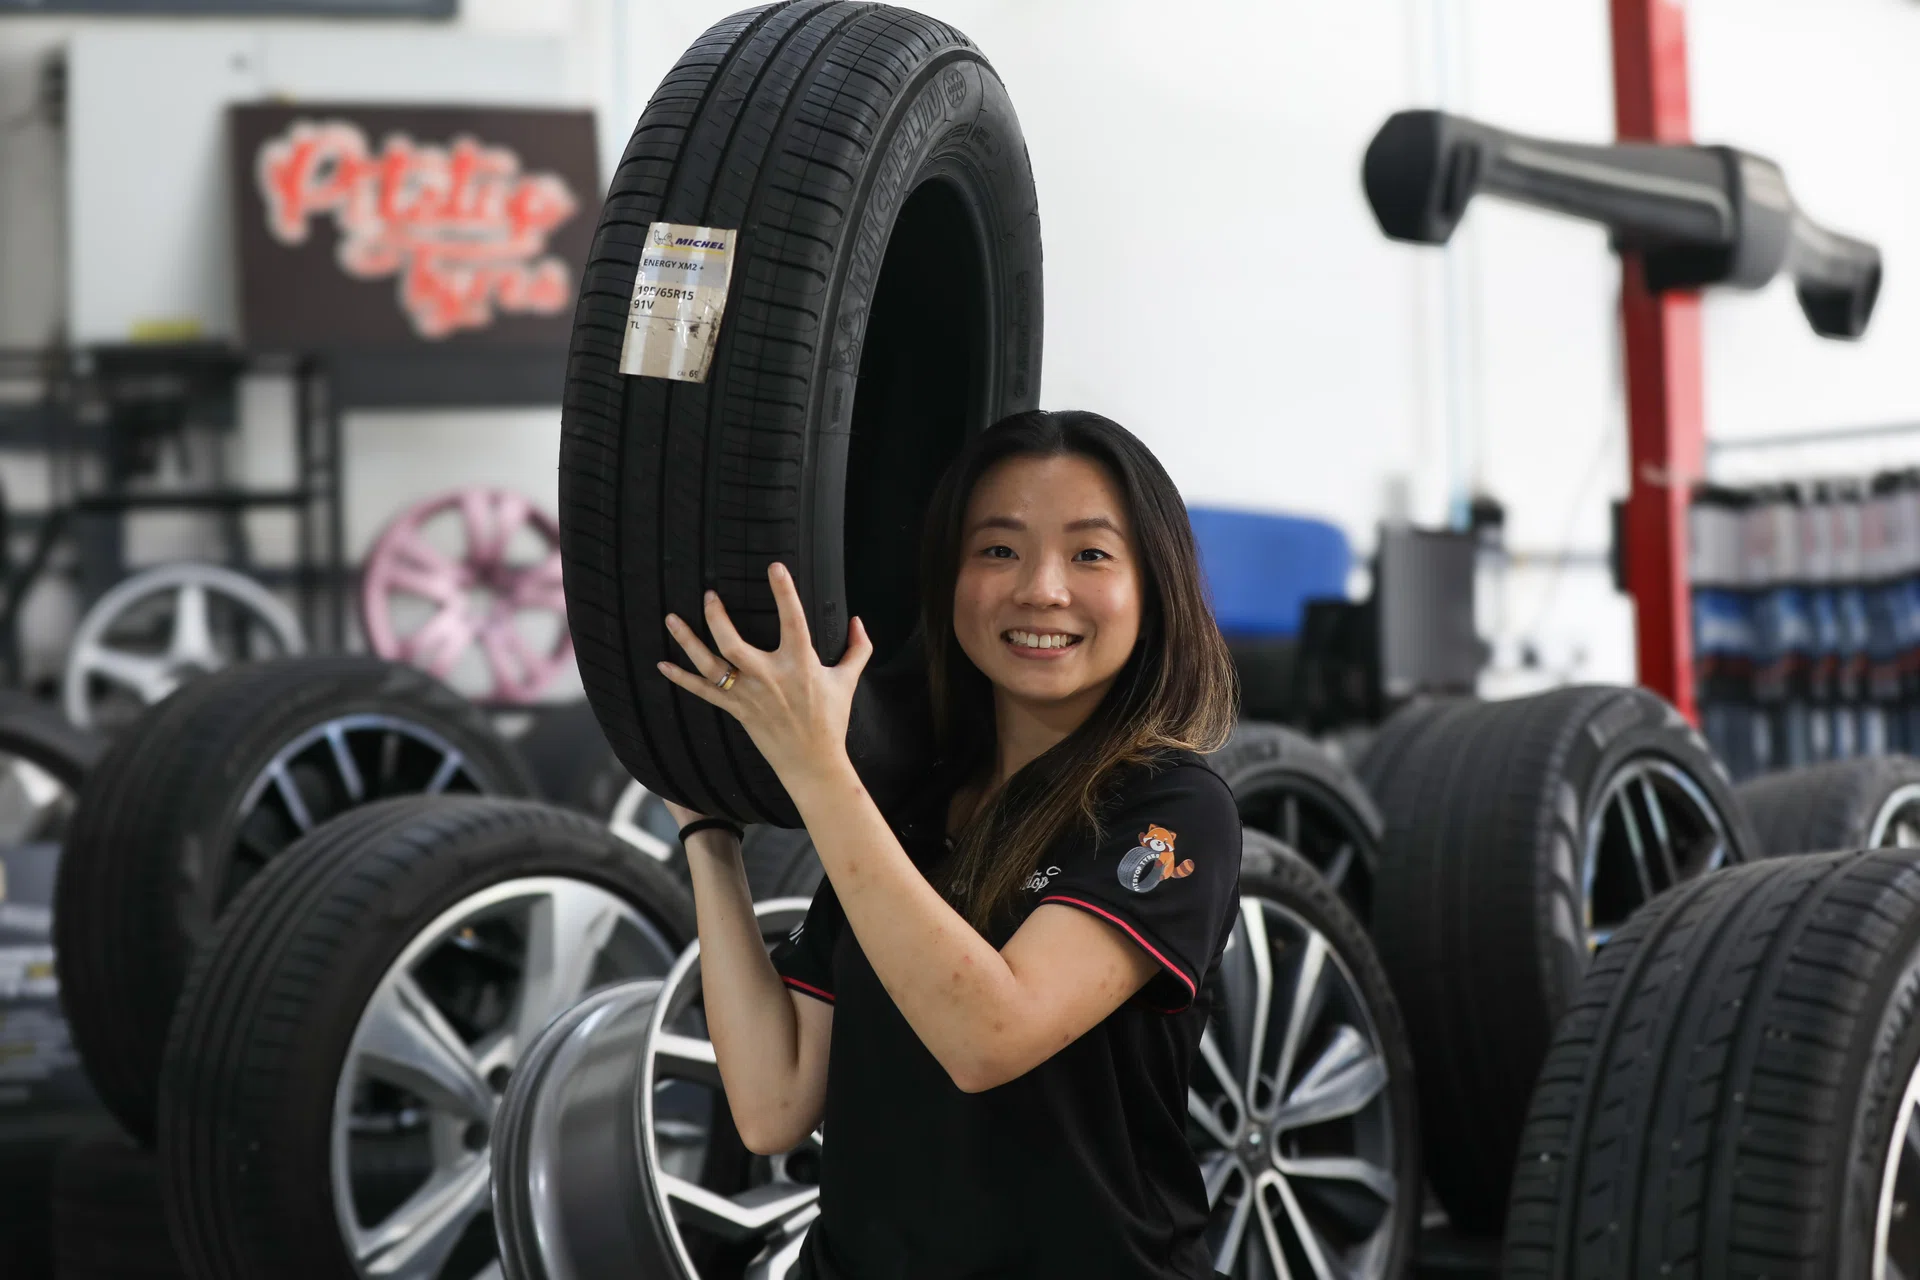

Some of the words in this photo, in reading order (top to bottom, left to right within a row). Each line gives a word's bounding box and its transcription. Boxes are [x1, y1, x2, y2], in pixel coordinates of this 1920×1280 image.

[849, 79, 942, 301] MICHELIN
[675, 237, 725, 250] MICHEL
[643, 258, 677, 269] ENERGY
[677, 261, 698, 271] XM2
[637, 285, 694, 301] 195/65R15
[633, 300, 655, 310] 91V
[630, 321, 640, 330] TL
